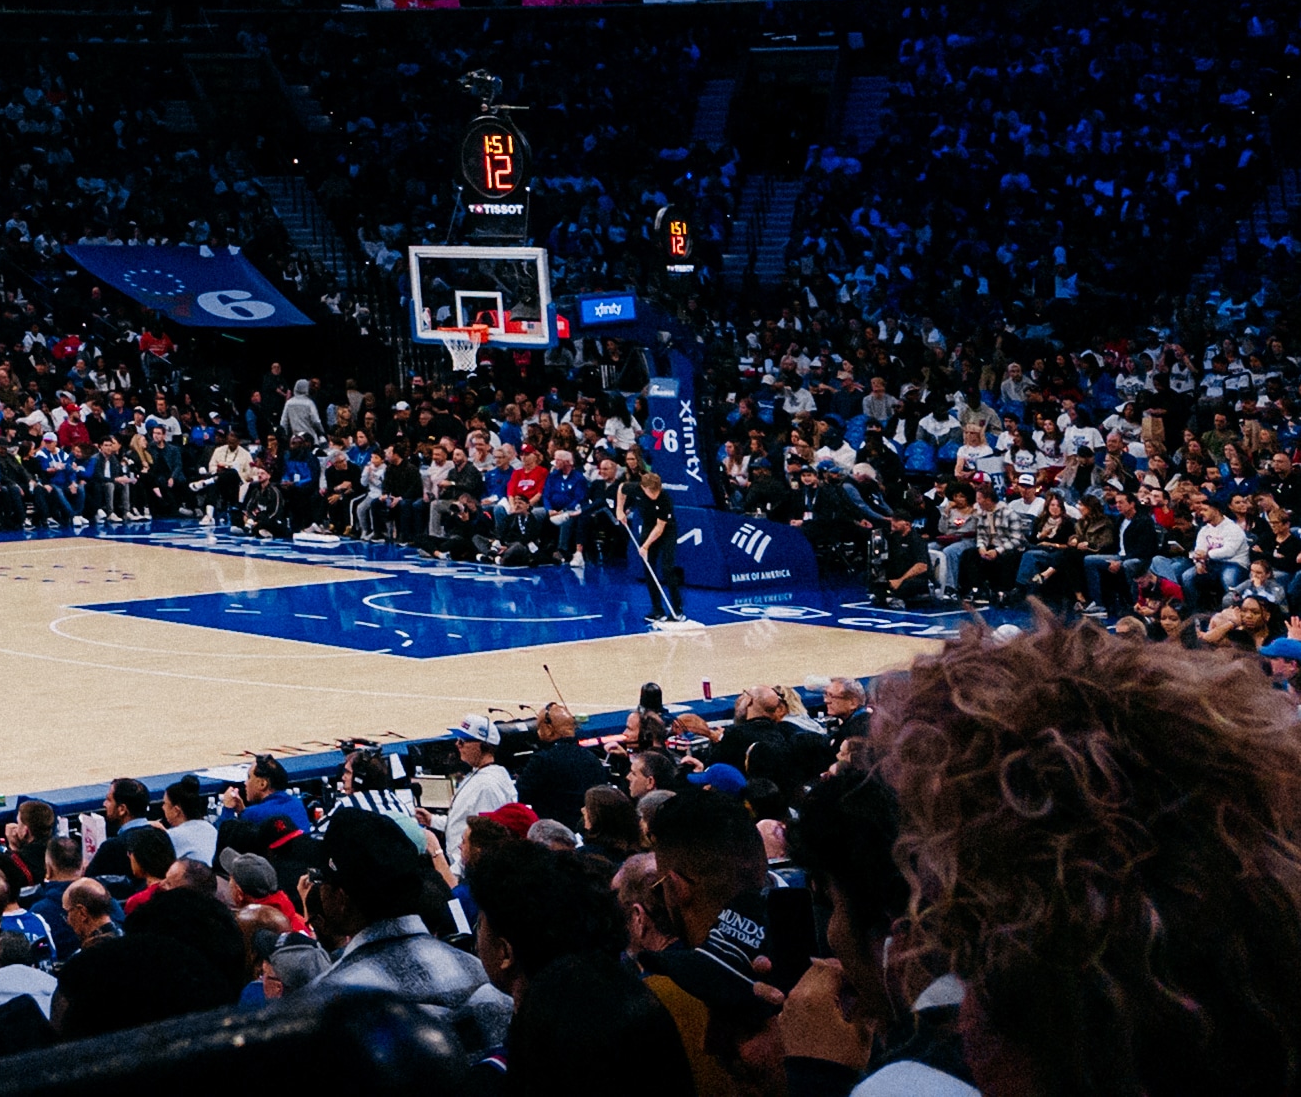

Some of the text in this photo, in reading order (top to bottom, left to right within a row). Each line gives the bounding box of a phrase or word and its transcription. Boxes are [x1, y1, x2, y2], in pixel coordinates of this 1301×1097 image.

[484, 136, 513, 155] 1:51
[484, 155, 513, 189] 12
[484, 204, 524, 215] TISSOT
[594, 302, 622, 318] xfinity
[651, 429, 678, 453] 76
[680, 400, 703, 483] xfinity
[732, 572, 750, 583] BANK
[751, 571, 760, 581] OF
